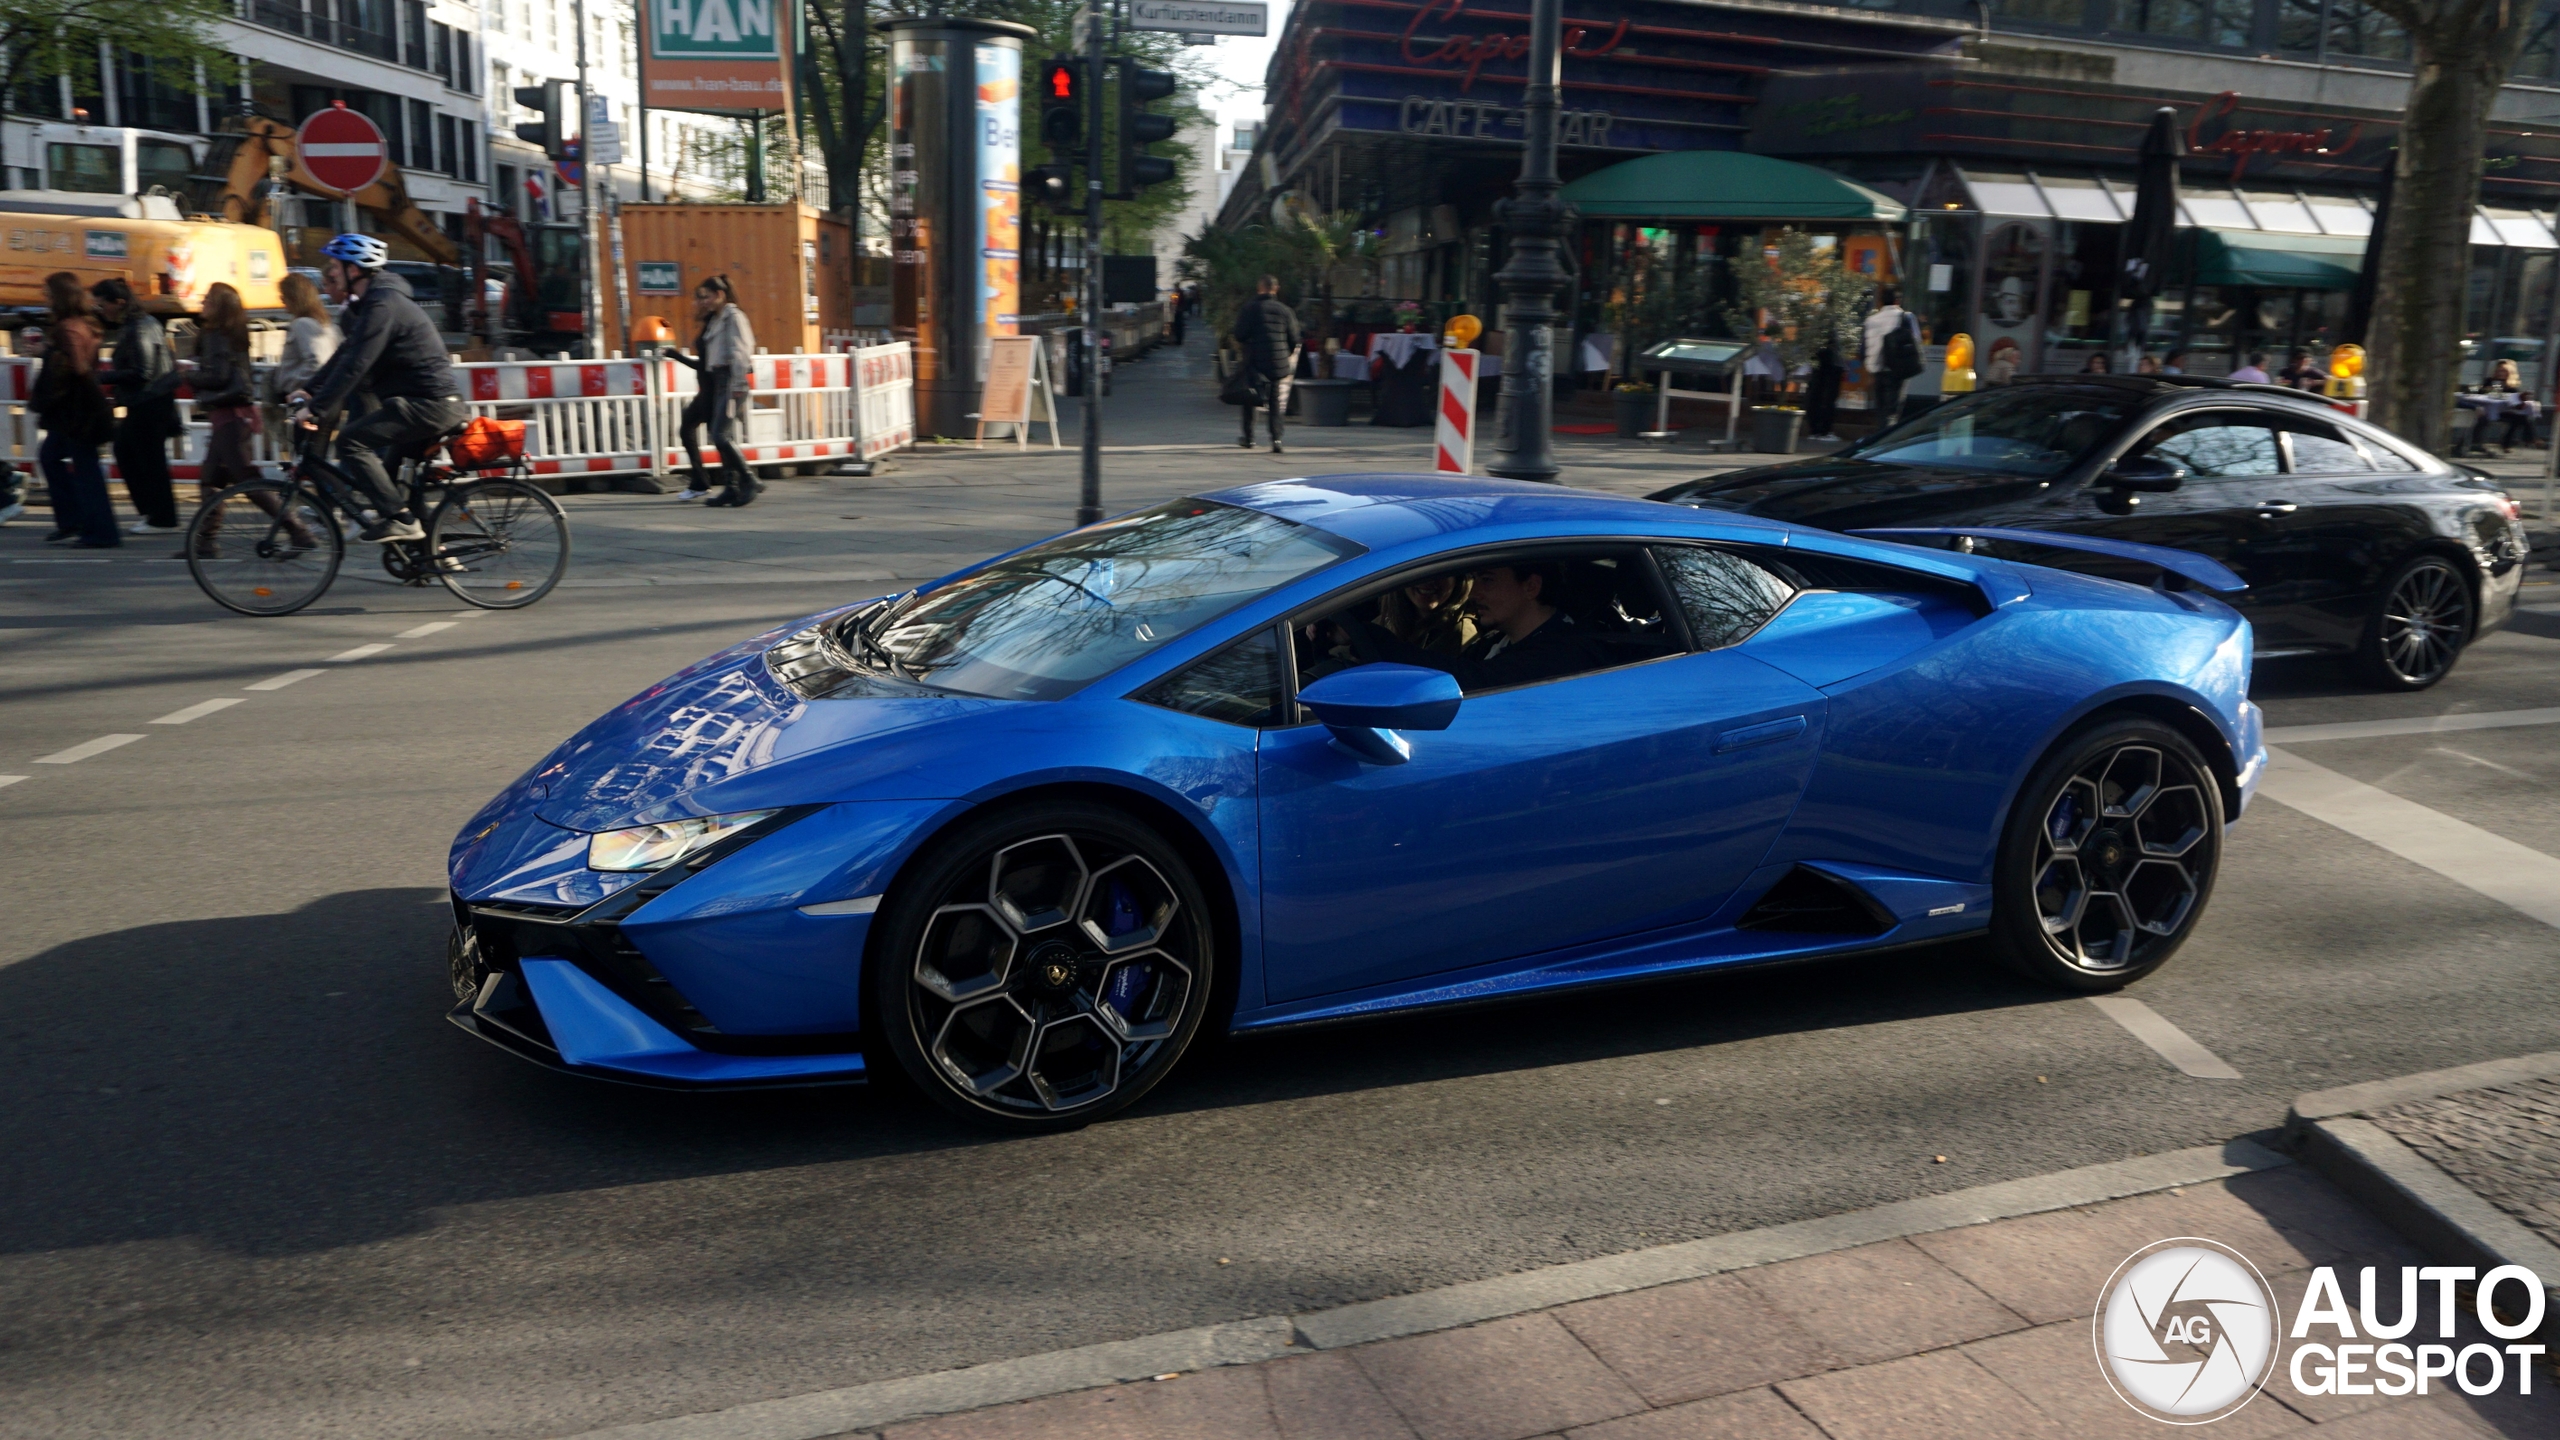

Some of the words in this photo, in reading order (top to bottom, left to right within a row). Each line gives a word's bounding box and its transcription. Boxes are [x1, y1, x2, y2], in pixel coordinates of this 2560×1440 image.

[660, 0, 772, 42] HAN
[1135, 3, 1261, 25] Kurfürstendamm
[1402, 0, 1630, 93] Capoe
